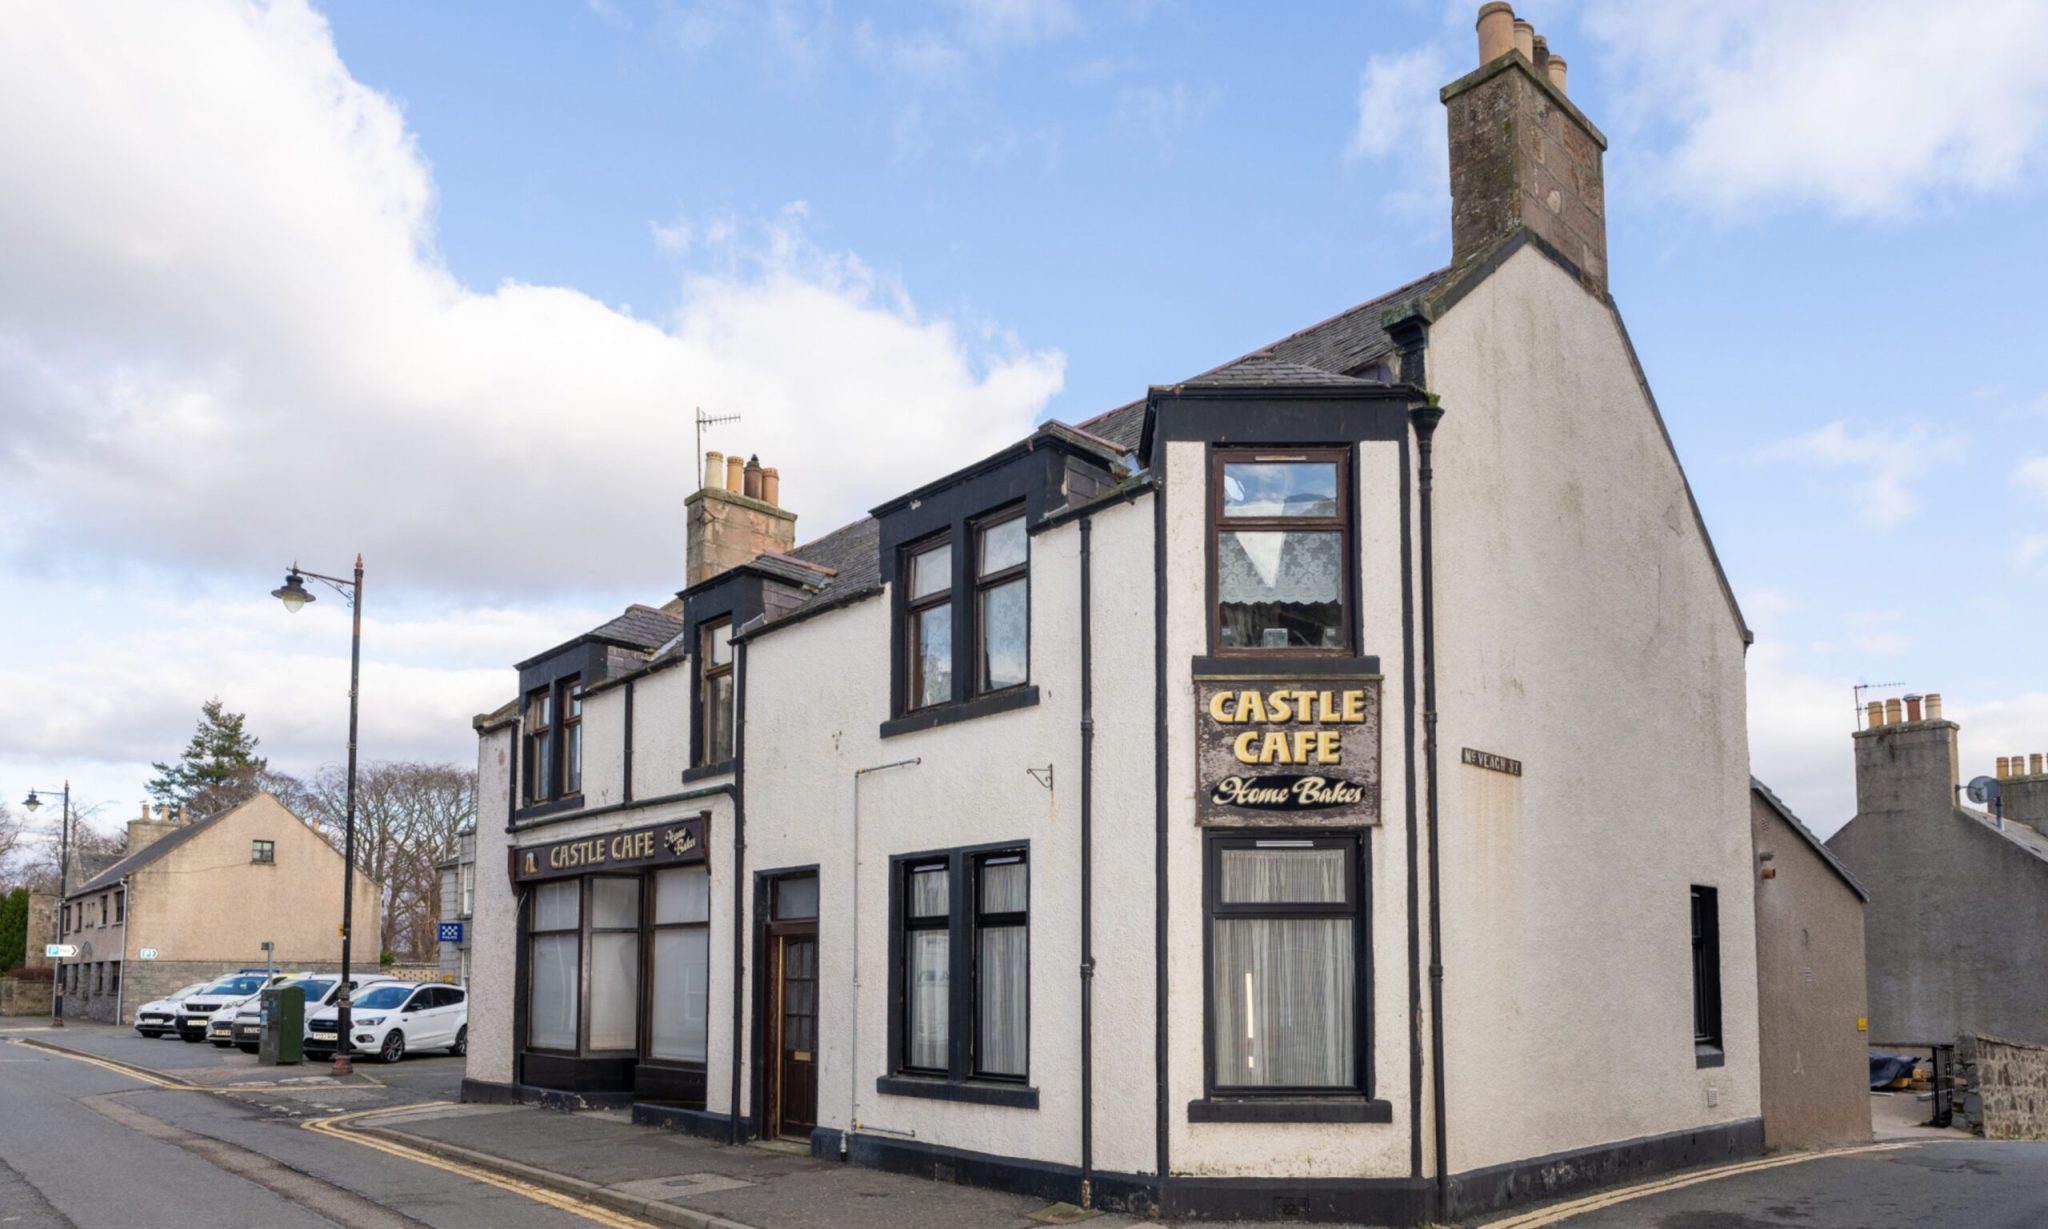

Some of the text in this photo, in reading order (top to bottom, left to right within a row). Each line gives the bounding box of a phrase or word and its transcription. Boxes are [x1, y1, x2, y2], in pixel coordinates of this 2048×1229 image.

[1209, 690, 1366, 724] CASTLE
[1233, 731, 1342, 765] CAFE
[1212, 776, 1364, 805] Home Bakes
[550, 831, 655, 869] CASTLE CAFE
